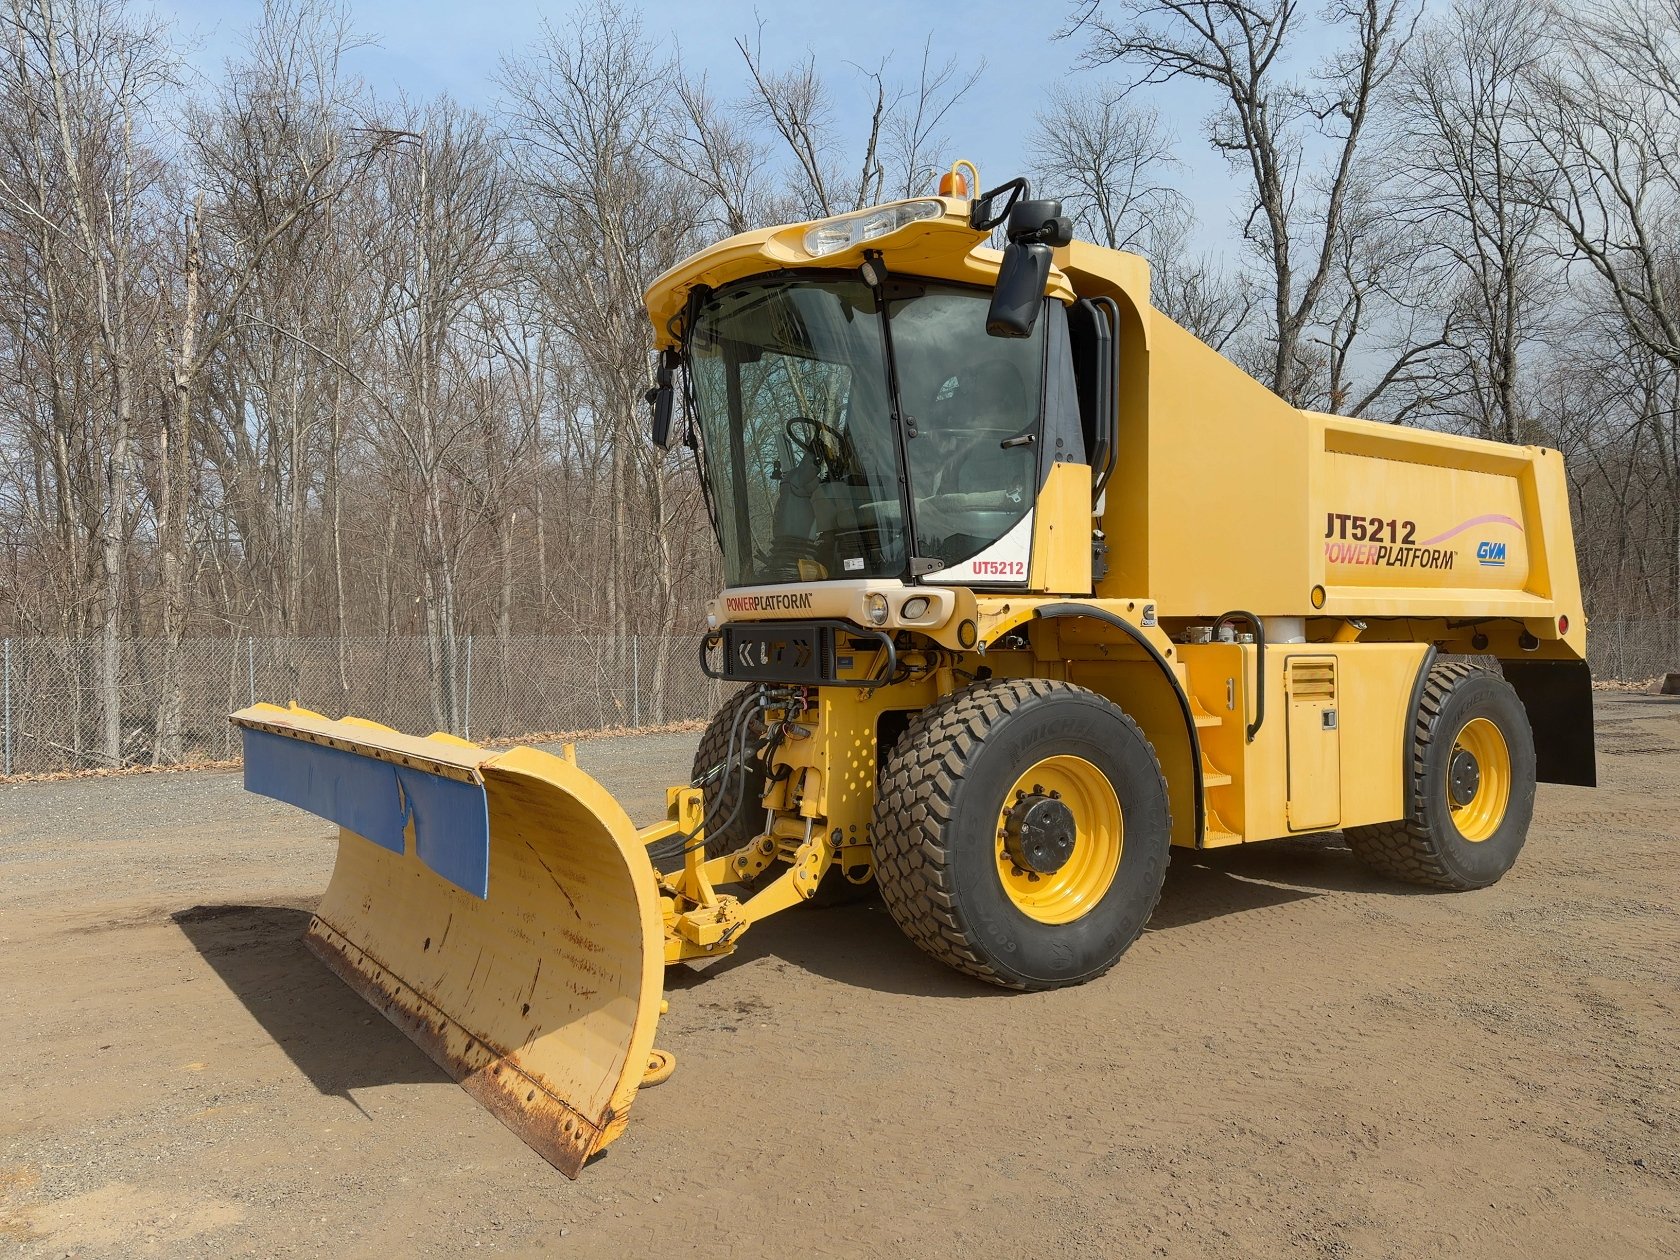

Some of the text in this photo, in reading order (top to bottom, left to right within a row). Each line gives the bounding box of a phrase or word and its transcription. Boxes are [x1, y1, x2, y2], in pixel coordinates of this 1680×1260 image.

[1325, 541, 1458, 569] OWERPLATFORM™
[1477, 541, 1506, 560] GVM
[973, 561, 1024, 575] UT5212
